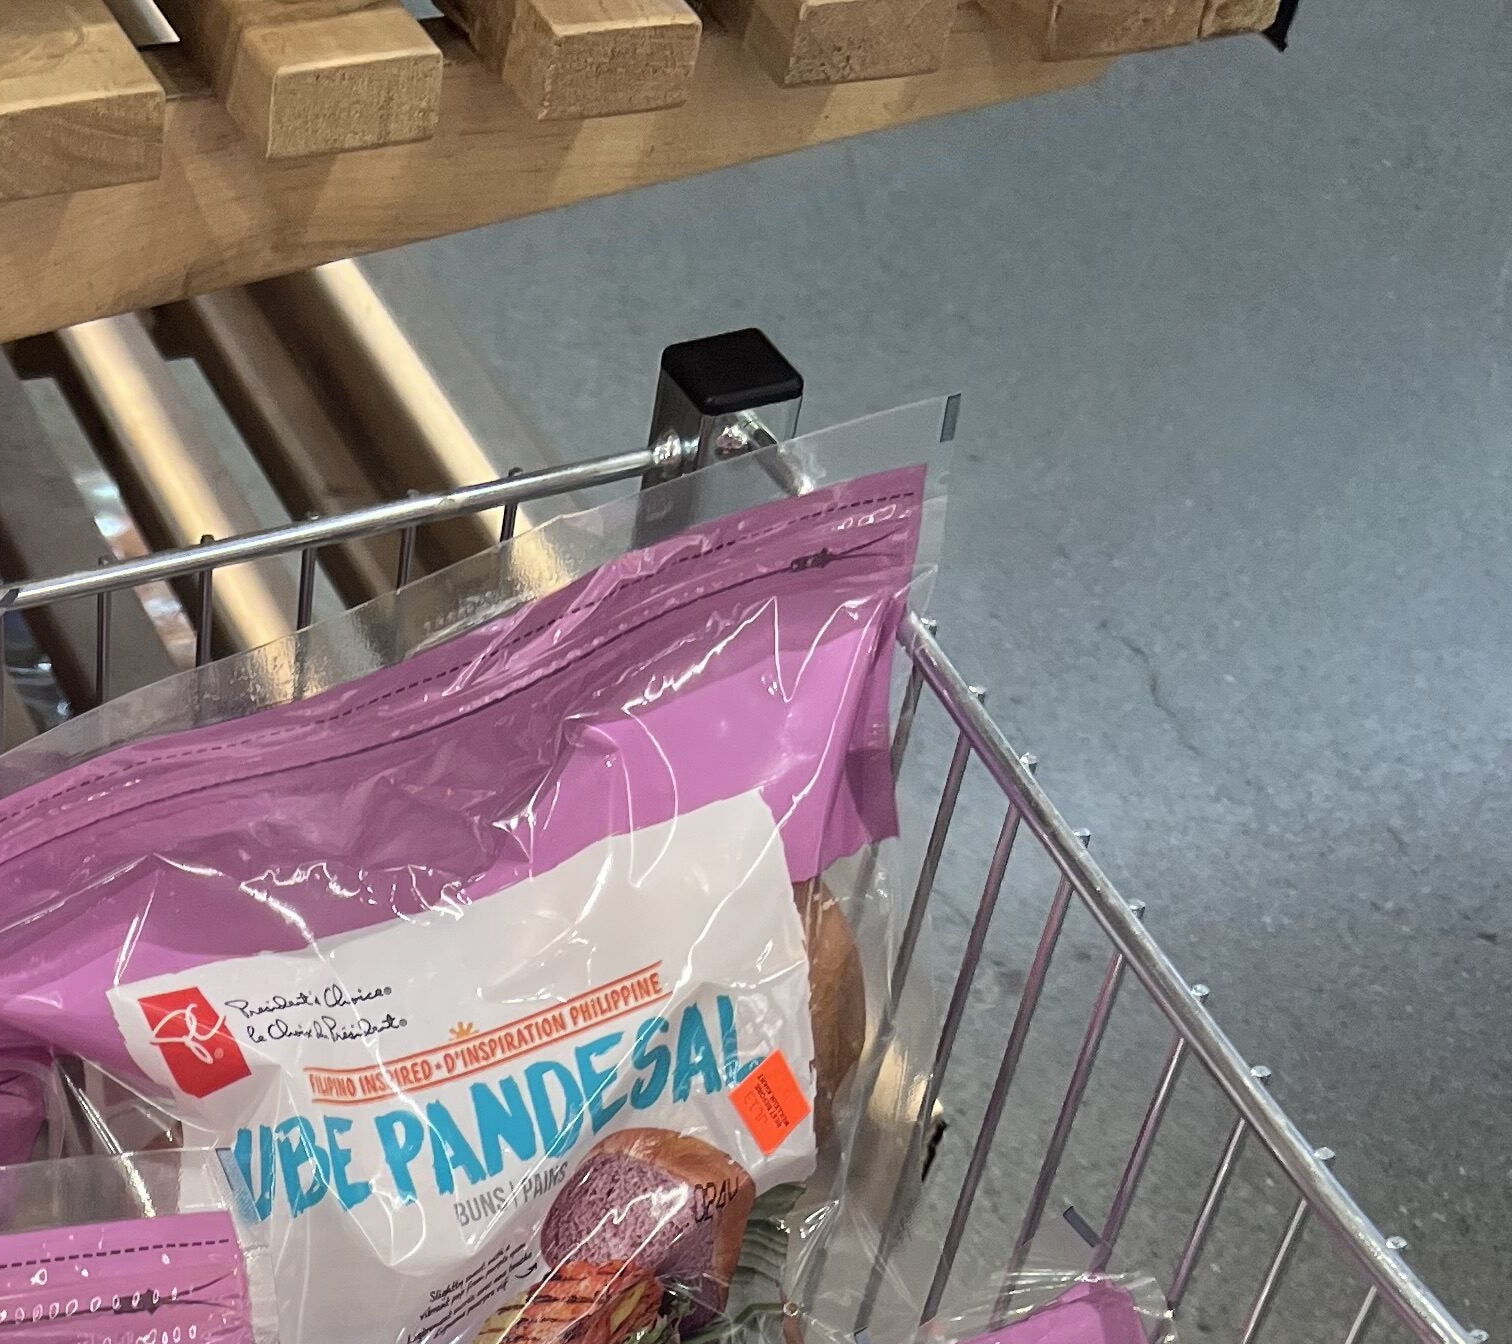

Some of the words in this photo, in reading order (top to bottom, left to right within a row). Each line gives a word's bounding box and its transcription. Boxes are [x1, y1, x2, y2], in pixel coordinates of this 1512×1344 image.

[308, 1072, 357, 1098] FILIPINO
[444, 1011, 566, 1075] D'INSPIRATION
[569, 971, 664, 1028] PHILIPPINE
[229, 1113, 373, 1226] UBE
[373, 994, 767, 1208] PANDESAL
[454, 1186, 506, 1228] BUNS
[522, 1160, 570, 1203] PAINS
